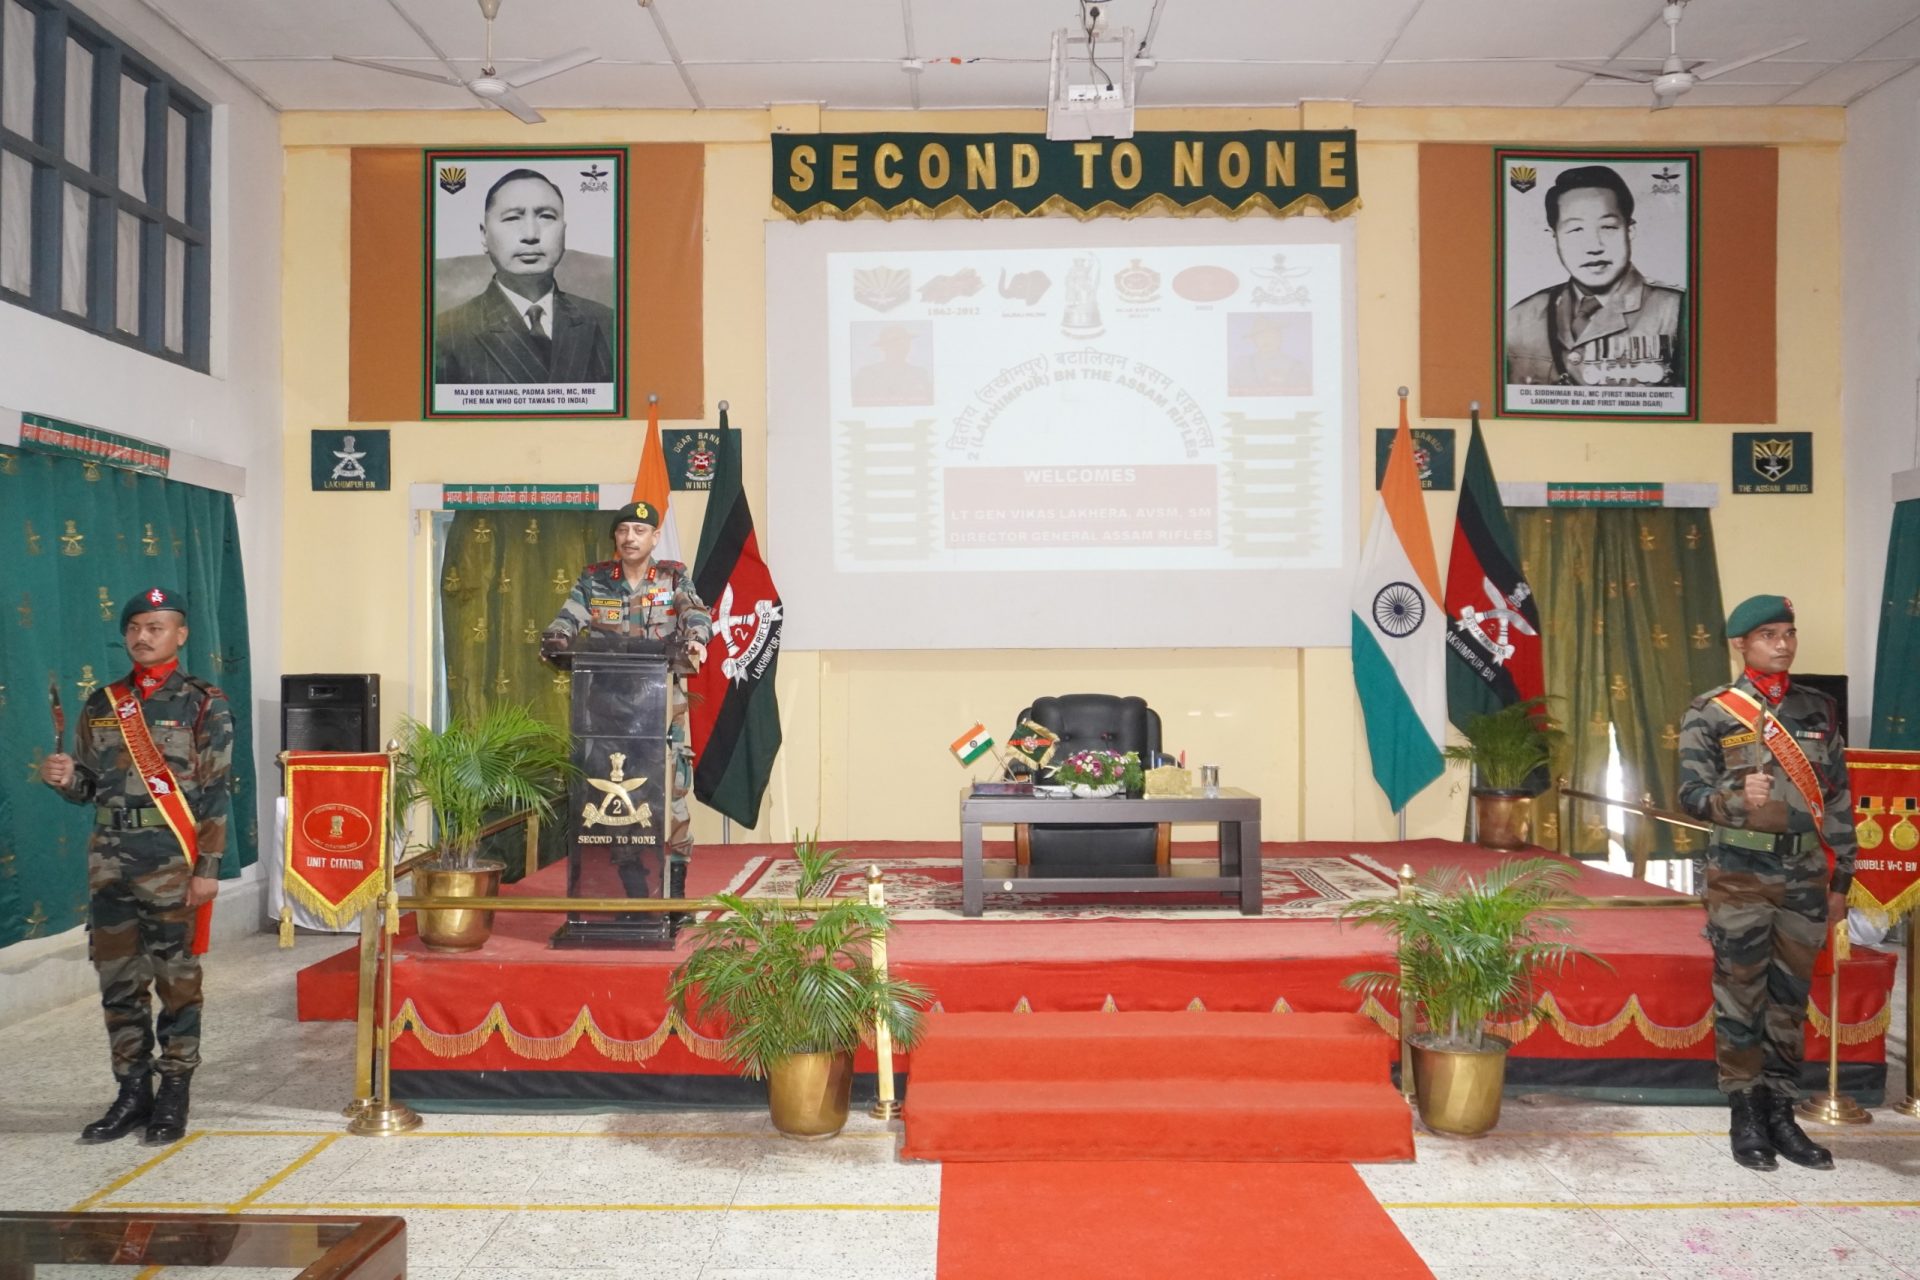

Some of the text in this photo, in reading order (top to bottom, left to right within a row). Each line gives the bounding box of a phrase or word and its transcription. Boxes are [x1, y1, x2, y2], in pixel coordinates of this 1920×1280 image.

[789, 141, 1347, 192] SECOND TO NONE
[1054, 346, 1129, 370] बटालियन
[1133, 361, 1175, 391] असम
[546, 388, 564, 396] SHRI,
[1601, 390, 1622, 398] (FIRST
[529, 397, 555, 405] TAWANG
[567, 397, 588, 405] INDIA)
[1530, 398, 1570, 406] LAKHIMPUR
[967, 368, 1199, 461] 2 (LAKHIMPUR) BN THE ASSAM RIFLES
[698, 432, 720, 445] BANN
[1023, 468, 1136, 484] WELCOMES
[323, 481, 364, 489] LAKHIMPUR
[685, 481, 712, 489] WINNE
[1738, 484, 1808, 492] THE ASSAM RIFLES
[951, 508, 967, 521] LT
[975, 508, 1008, 521] GEN
[1010, 507, 1056, 521] VIKAS
[1187, 507, 1212, 518] SM
[950, 528, 1214, 543] DIRECTOR GENERAL ASSAM RIFLES
[734, 627, 749, 641] 2
[1487, 623, 1497, 635] 2
[735, 611, 771, 670] ASSAM RIFLES
[752, 636, 780, 680] LAKHIMPUR
[1446, 630, 1484, 671] AKHIMPUR
[1482, 667, 1497, 682] BN
[612, 799, 622, 815] 2
[578, 835, 656, 845] SECOND TO NONE
[306, 856, 364, 870] UNIT CITATION
[1905, 862, 1917, 872] BN
